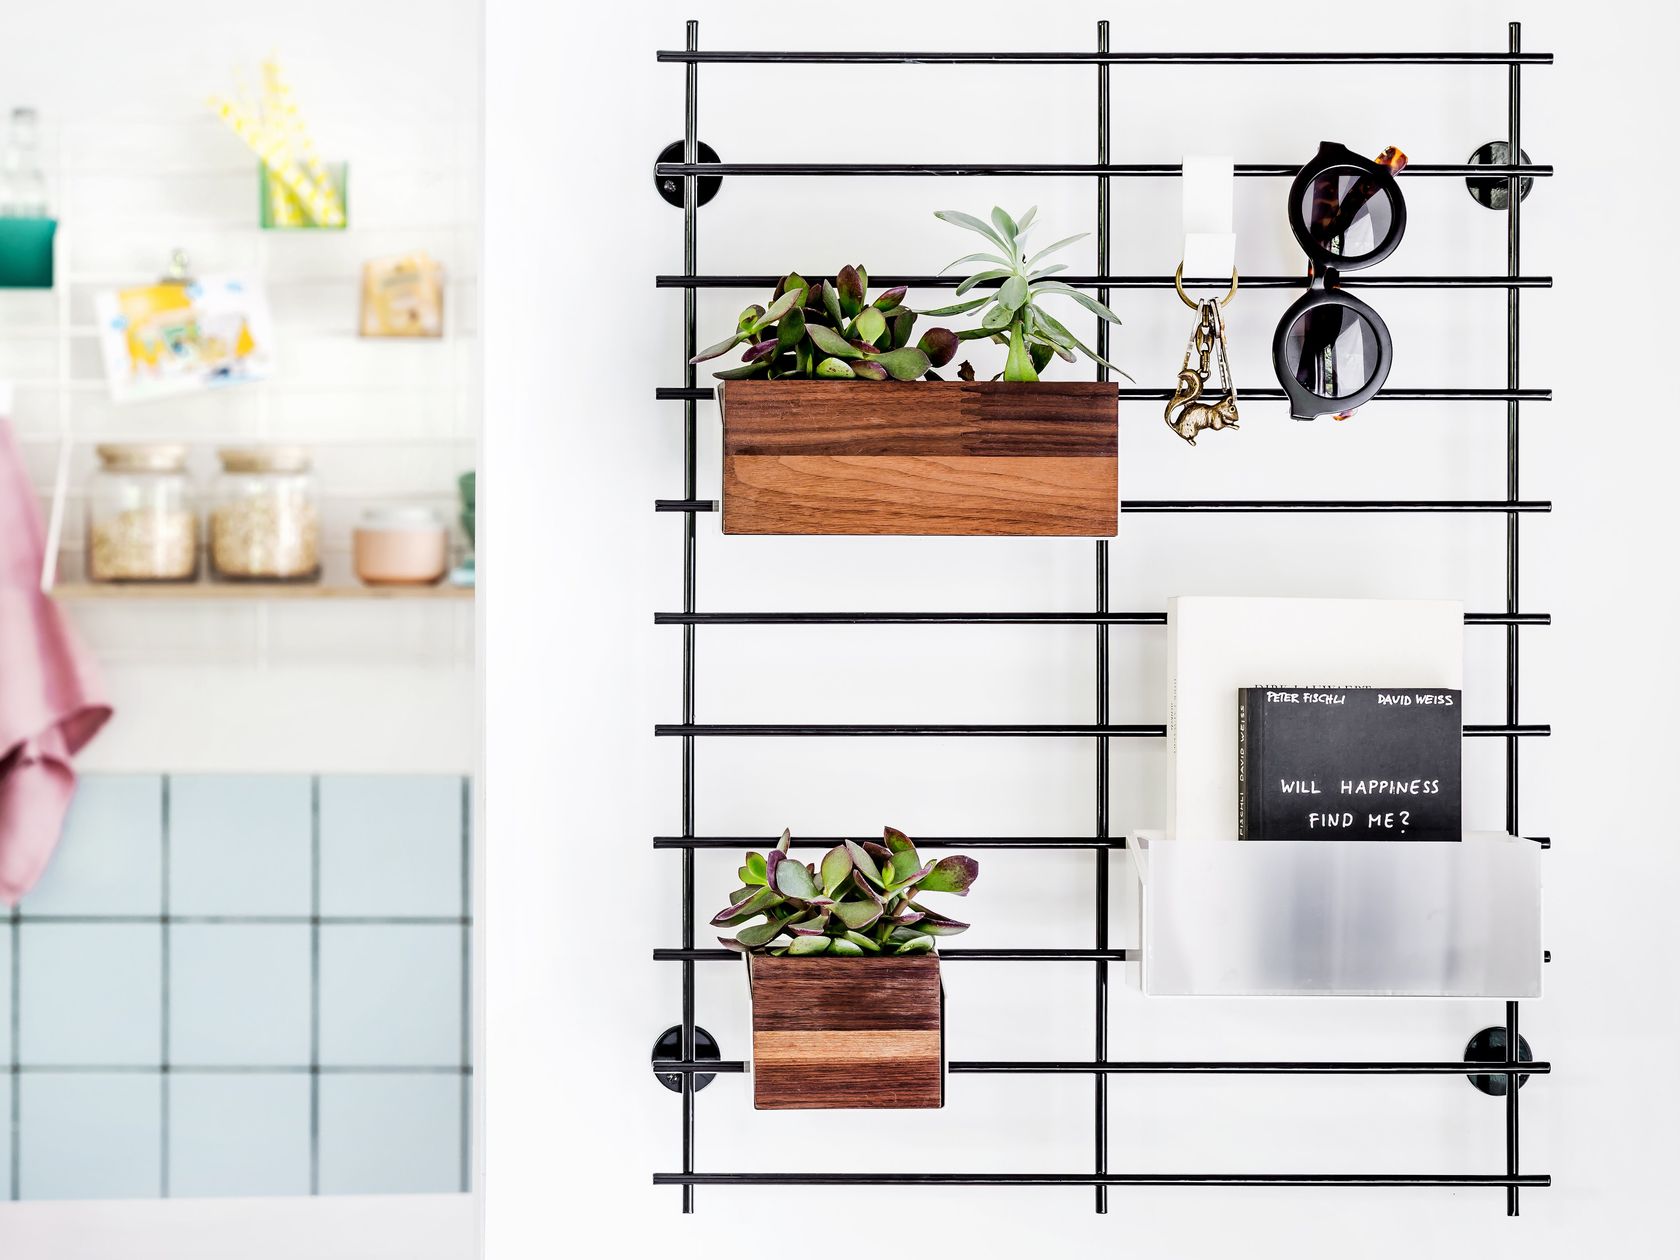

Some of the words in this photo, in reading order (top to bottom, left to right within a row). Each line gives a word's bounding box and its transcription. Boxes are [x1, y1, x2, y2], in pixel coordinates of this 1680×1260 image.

[1266, 691, 1300, 703] PETER
[1302, 692, 1346, 705] FISCHLI
[1377, 693, 1412, 706] DAVID
[1415, 694, 1454, 706] WEISS
[1280, 779, 1321, 794] WILL
[1340, 779, 1440, 795] HAPPINESS
[1309, 812, 1354, 829] FIND
[1368, 810, 1410, 834] ME?
